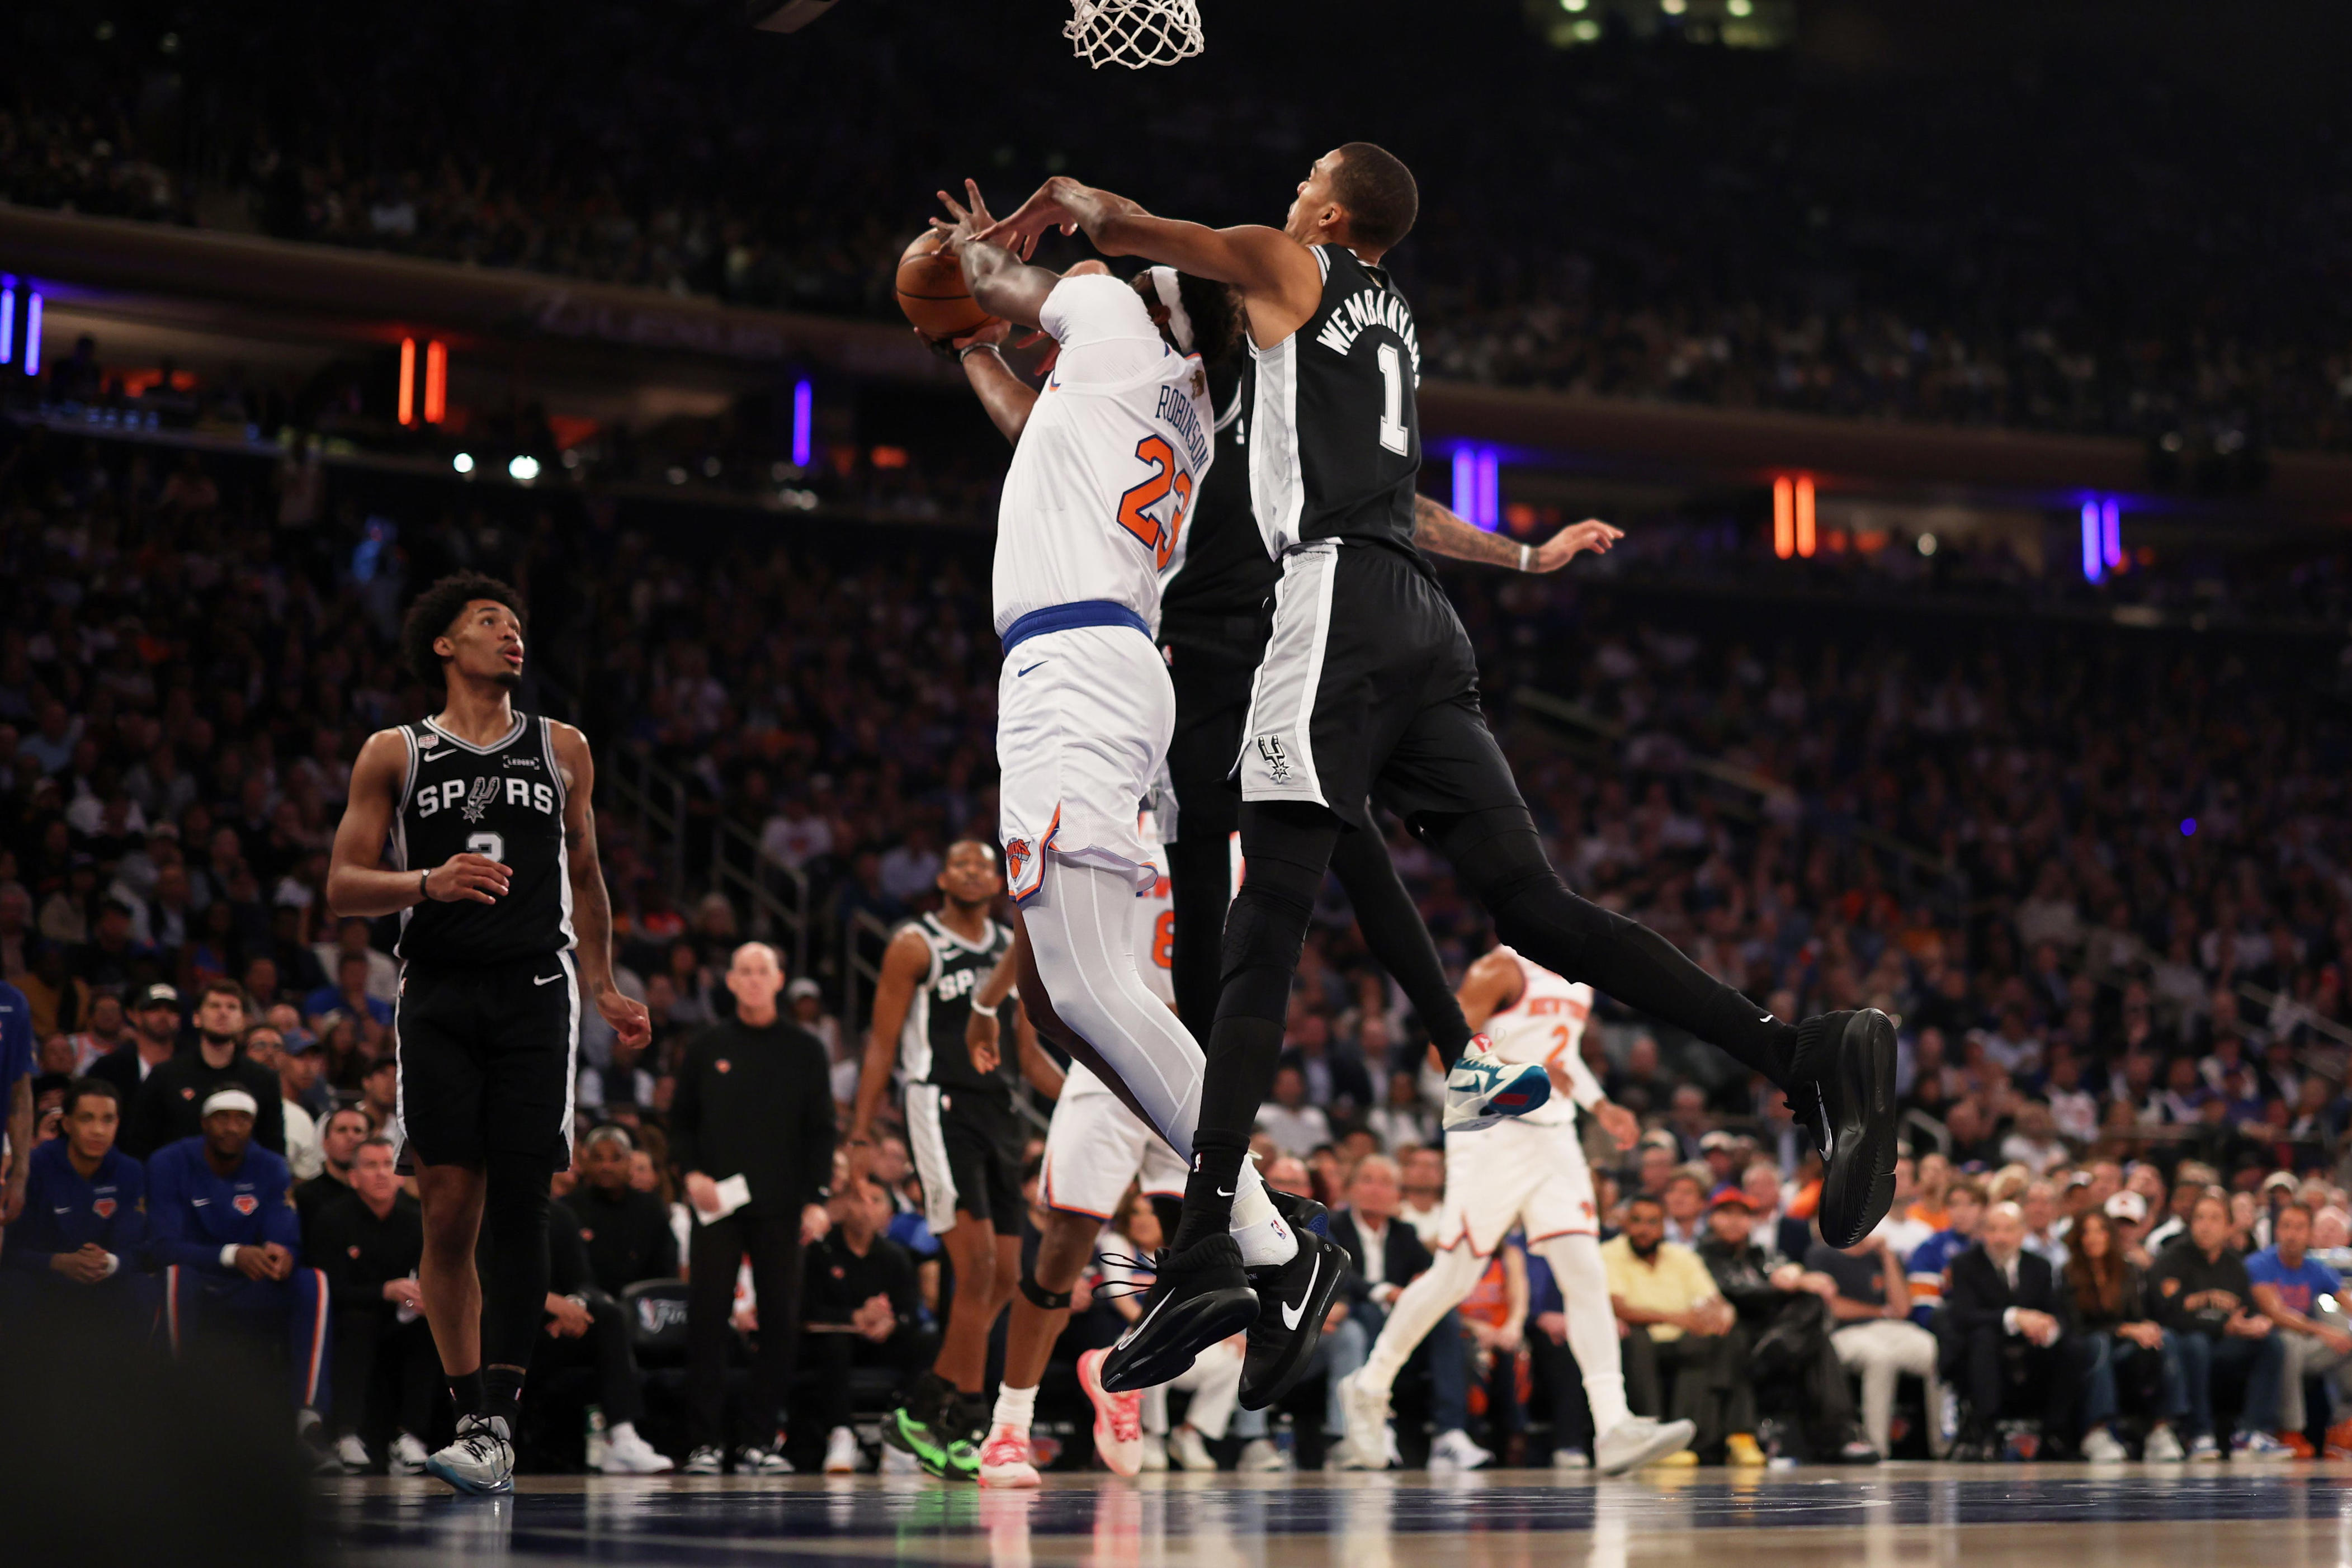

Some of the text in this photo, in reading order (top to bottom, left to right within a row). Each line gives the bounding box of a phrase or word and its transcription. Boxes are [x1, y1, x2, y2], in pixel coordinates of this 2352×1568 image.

[1155, 385, 1208, 474] ROBINSON
[1377, 342, 1409, 457] 1
[1116, 434, 1193, 573] 23
[1545, 1024, 1569, 1069] 2
